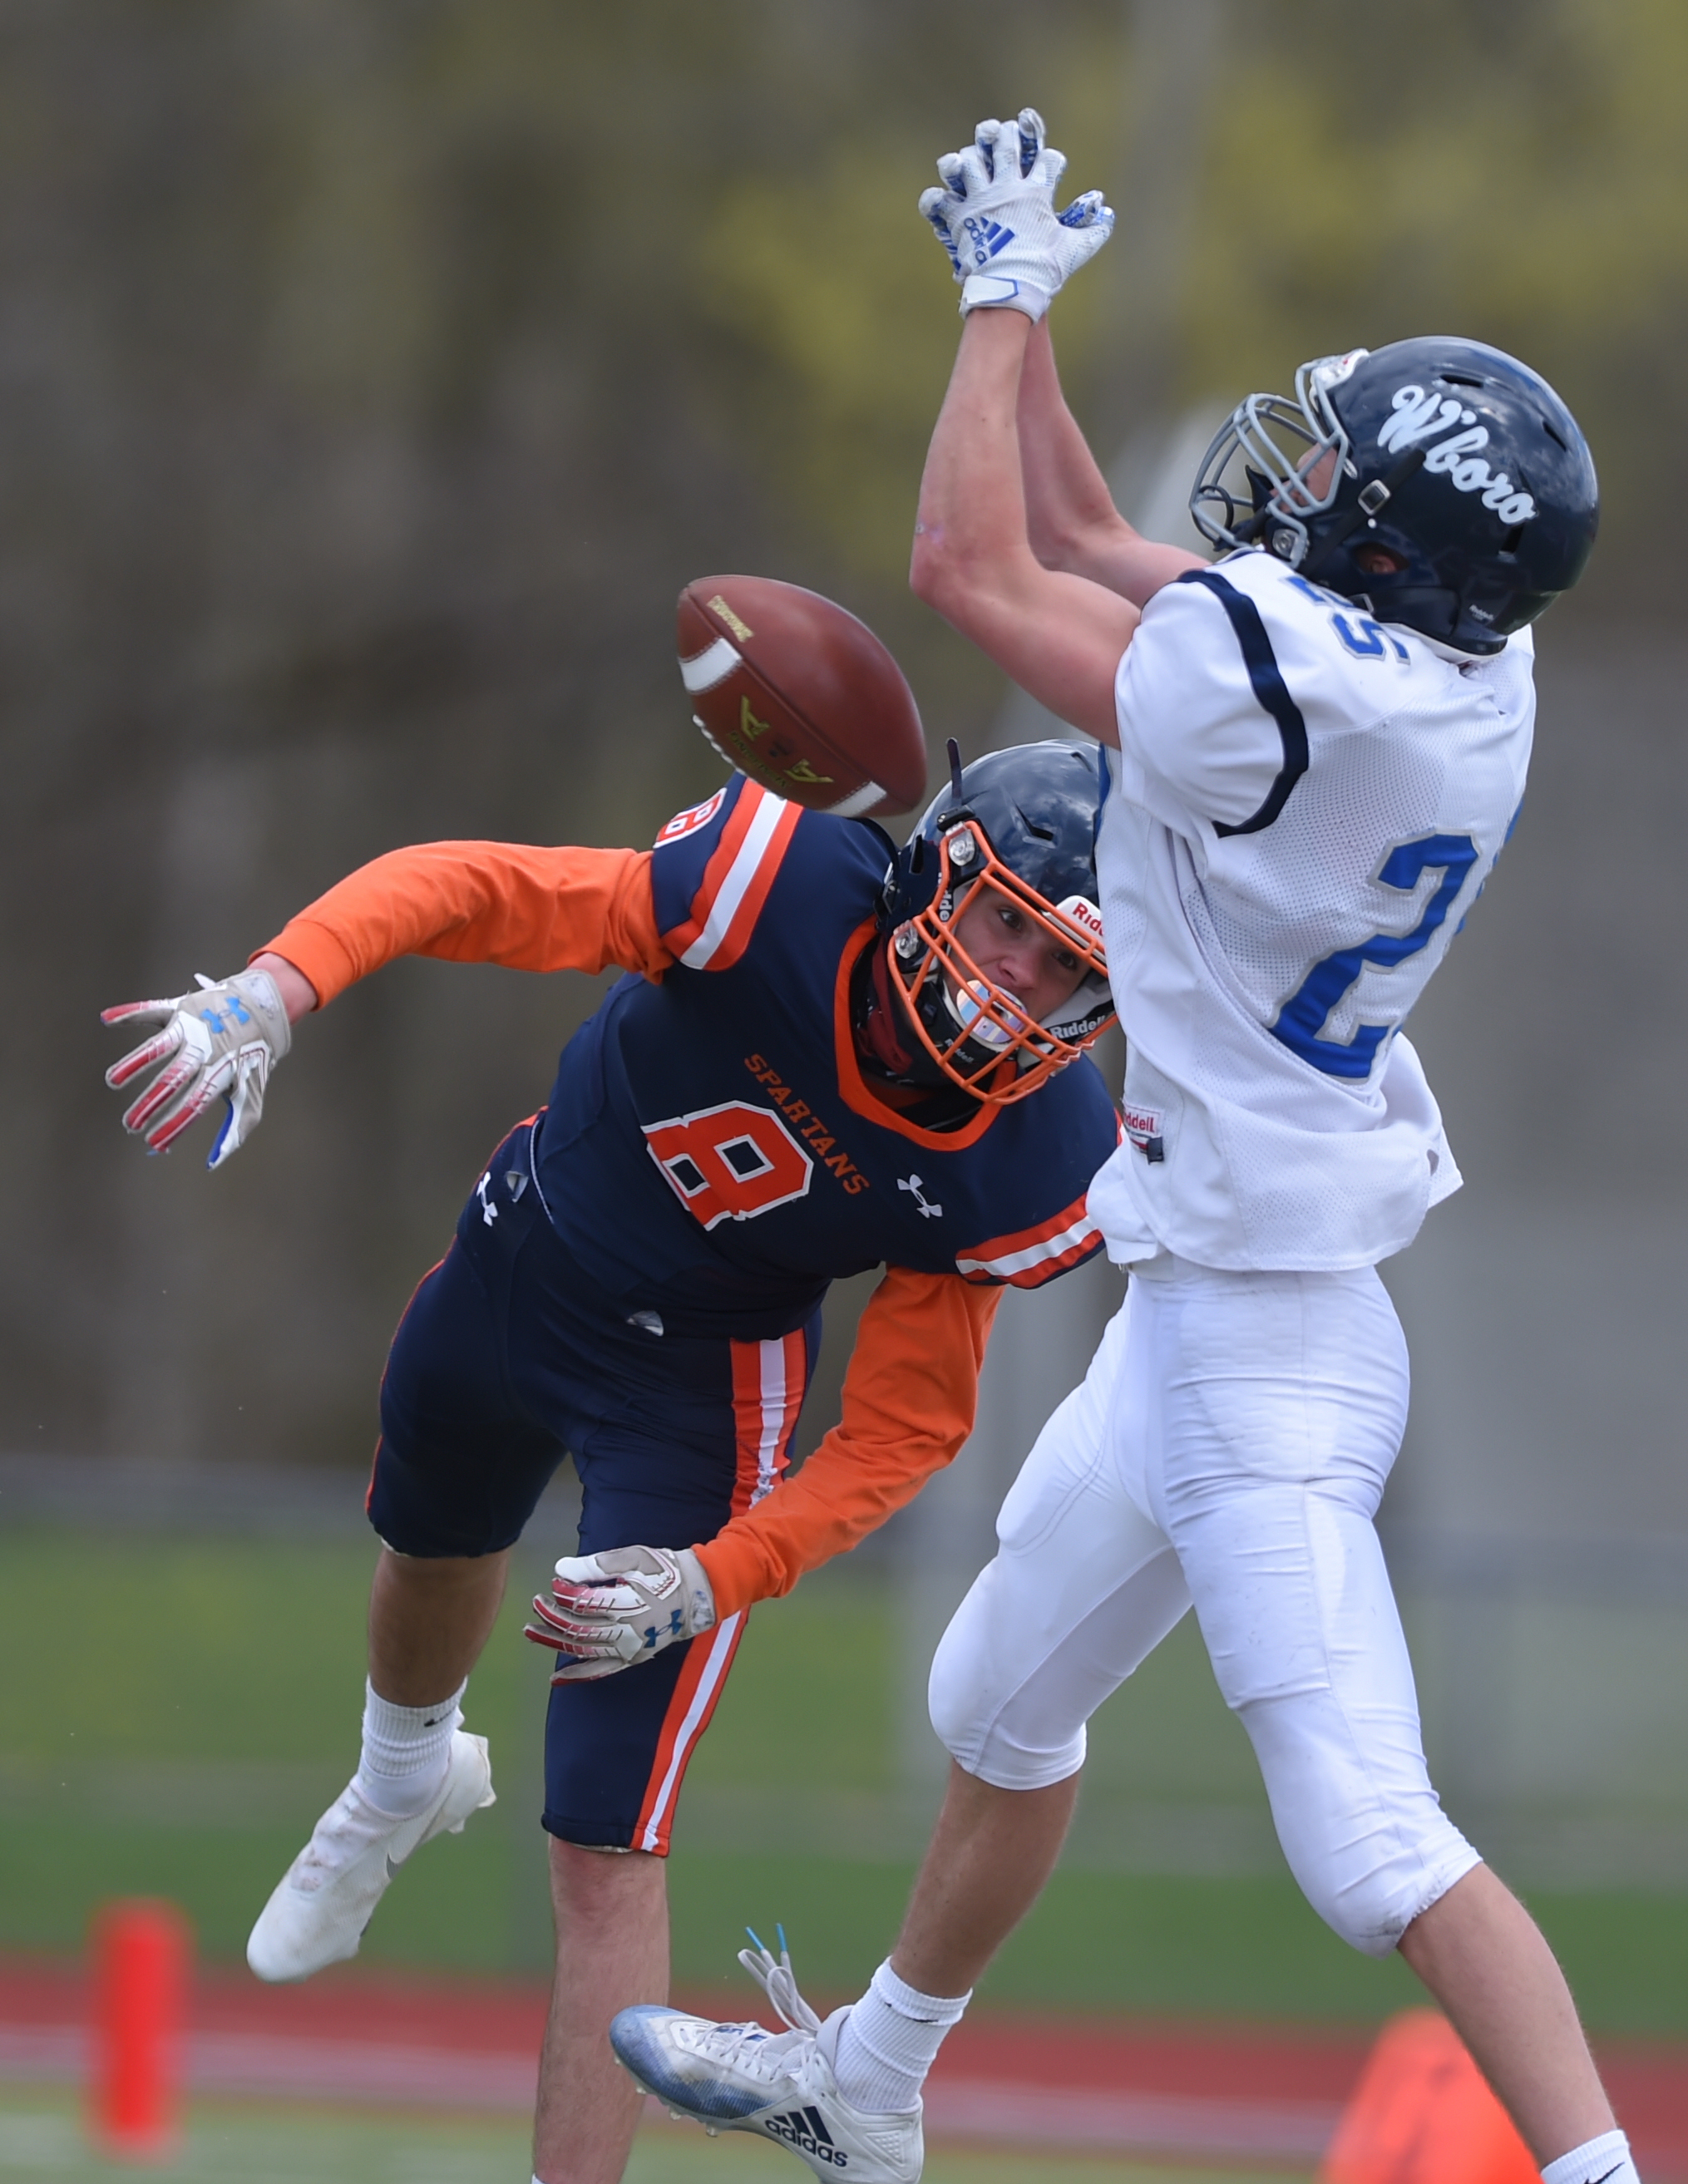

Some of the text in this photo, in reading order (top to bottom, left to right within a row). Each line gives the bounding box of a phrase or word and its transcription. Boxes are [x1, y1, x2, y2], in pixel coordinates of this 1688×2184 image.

[652, 786, 728, 849] 8
[743, 1053, 870, 1196] SPARTANS
[1124, 1112, 1155, 1133] ddell
[639, 1100, 815, 1232] 8
[764, 2119, 848, 2167] adidas
